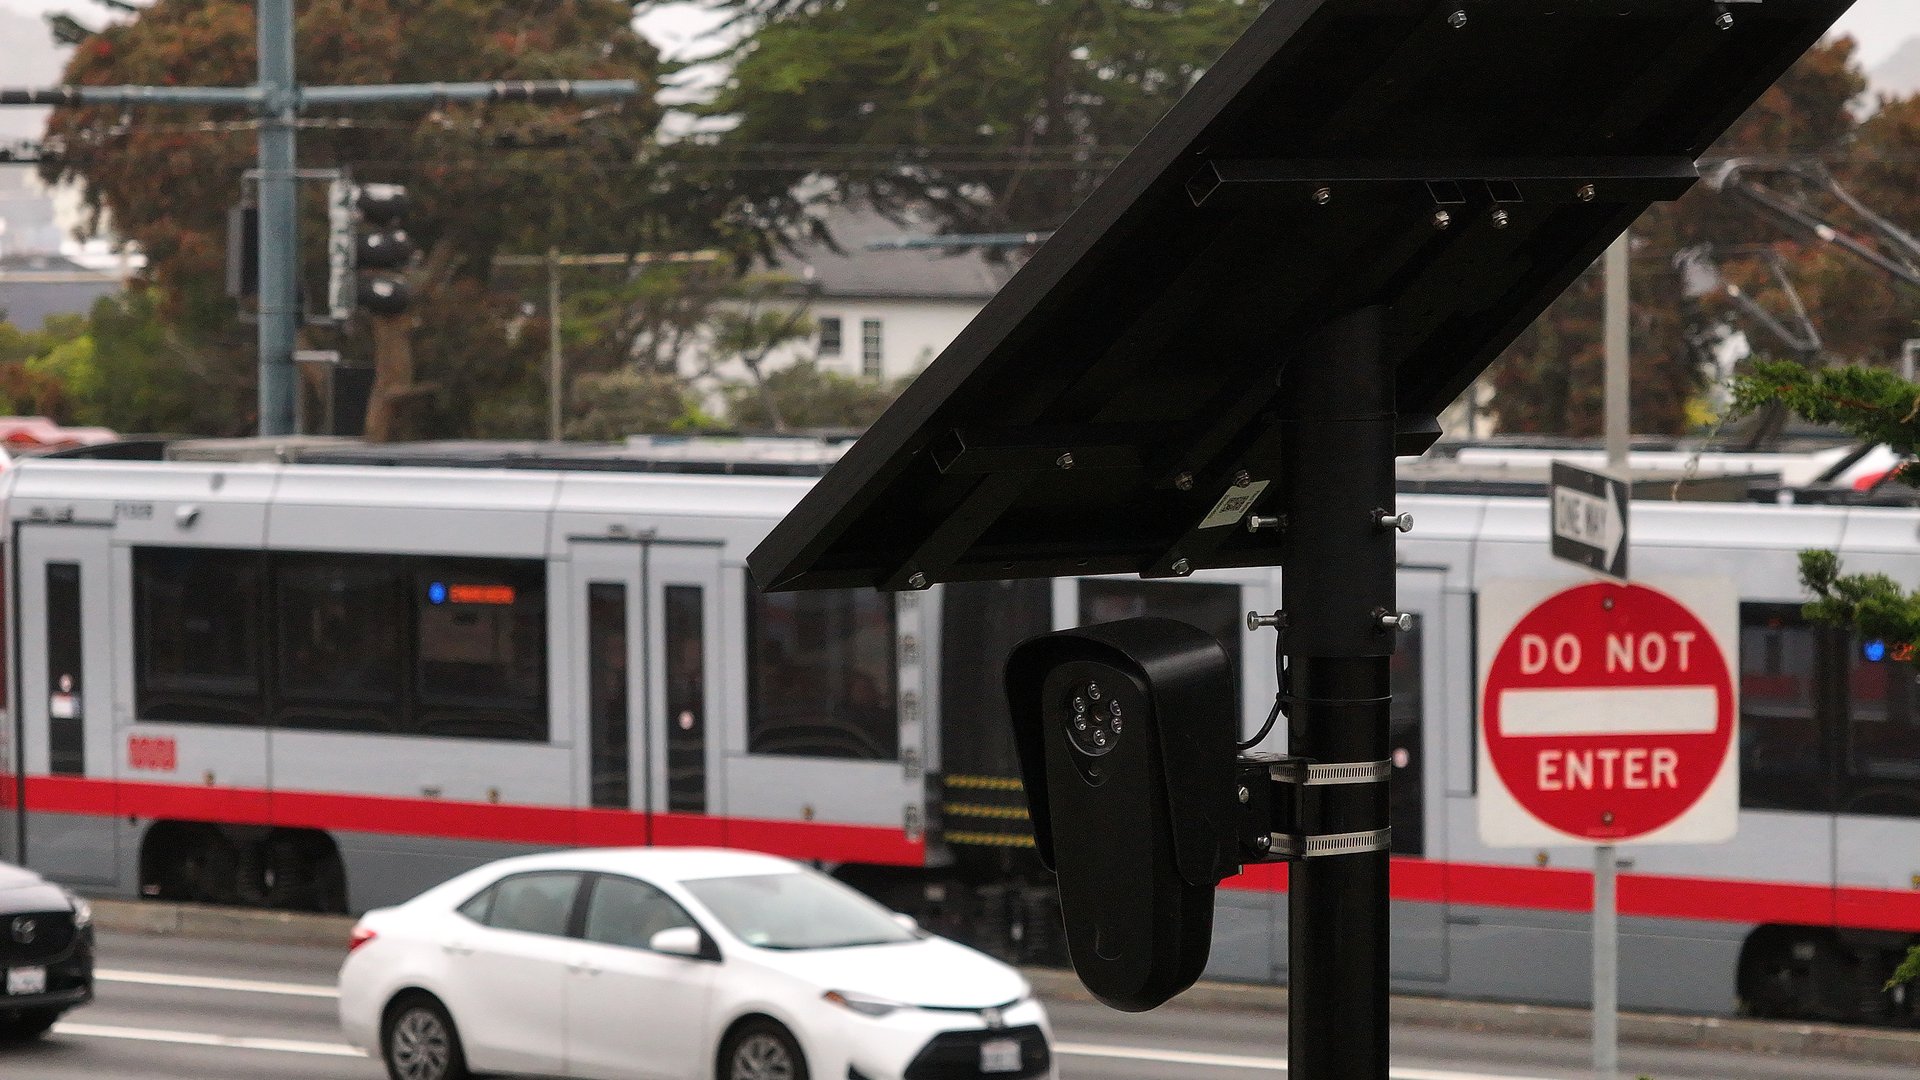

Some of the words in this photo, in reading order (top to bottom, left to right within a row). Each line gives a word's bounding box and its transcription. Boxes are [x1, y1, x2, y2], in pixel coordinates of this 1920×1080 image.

[1558, 494, 1582, 535] ONE
[1585, 503, 1607, 539] WAY
[1520, 633, 1582, 675] DO
[1606, 631, 1696, 674] NOT
[1536, 748, 1679, 791] ENTER
